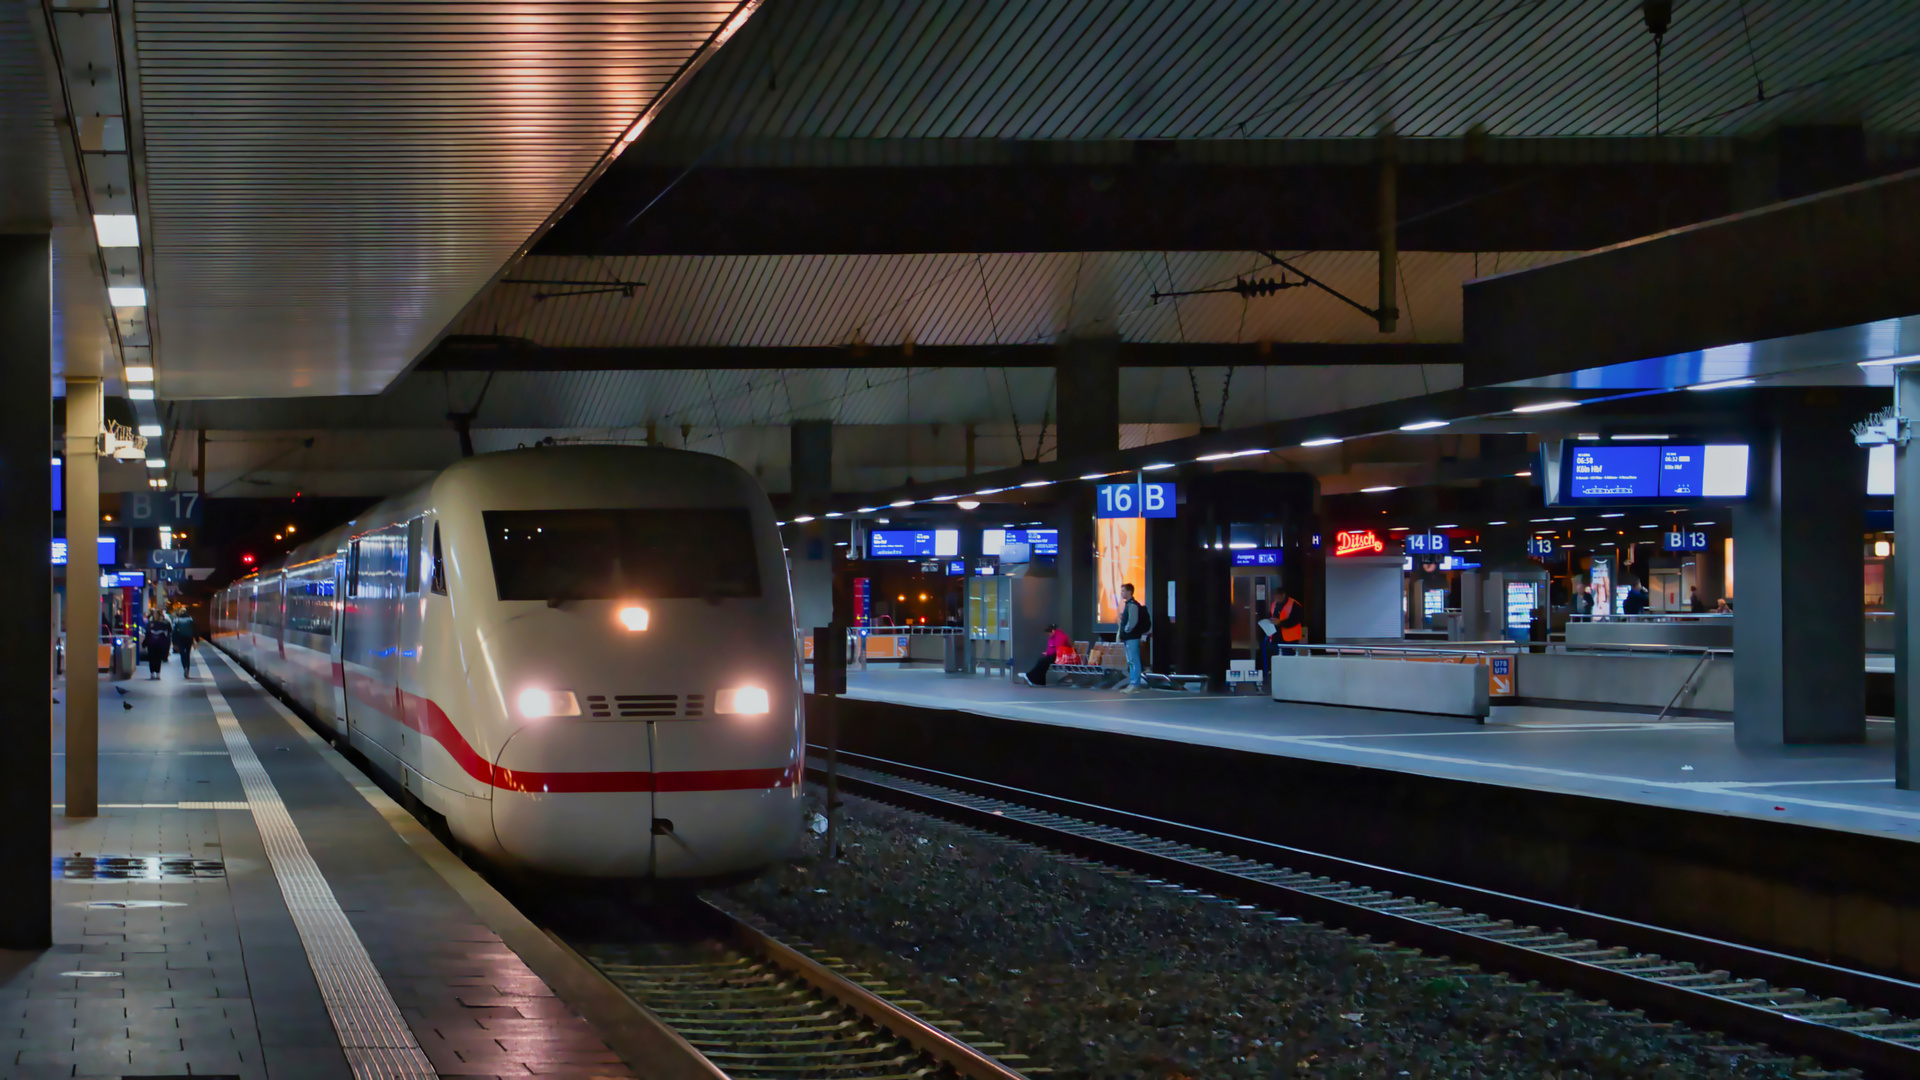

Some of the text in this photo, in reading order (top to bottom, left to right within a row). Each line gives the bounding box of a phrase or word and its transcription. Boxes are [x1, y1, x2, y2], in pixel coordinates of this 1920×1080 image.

[1576, 465, 1603, 473] Köln Hbf
[133, 492, 199, 519] B 17
[1101, 484, 1164, 512] 16 B
[1312, 535, 1319, 545] H
[1336, 531, 1376, 552] Ditsch
[1408, 535, 1443, 550] 14 B
[1537, 539, 1552, 554] 13
[1670, 532, 1706, 548] B 13
[152, 548, 188, 564] C 17
[160, 569, 184, 579] D 17
